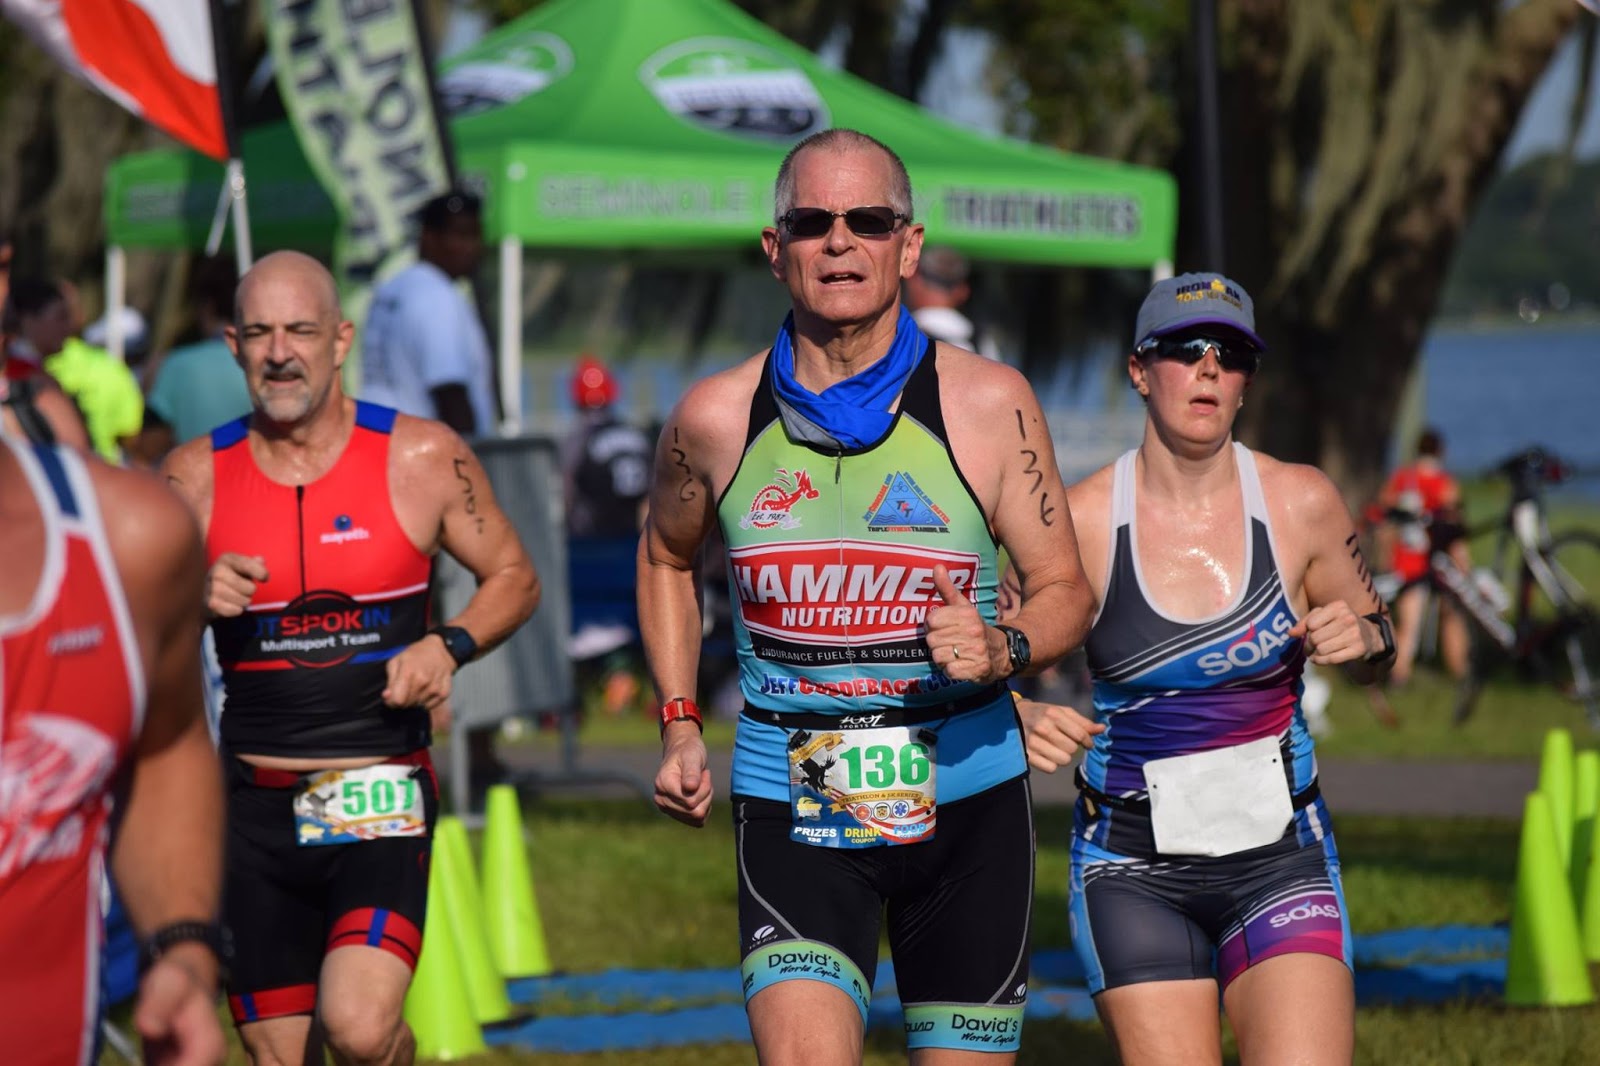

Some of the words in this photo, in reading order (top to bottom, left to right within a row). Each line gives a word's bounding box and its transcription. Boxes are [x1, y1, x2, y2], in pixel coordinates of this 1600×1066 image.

[672, 427, 696, 502] 136
[781, 605, 926, 628] NUTRITION
[260, 637, 336, 652] Multisport
[339, 632, 380, 645] Team
[1197, 612, 1293, 676] SOAS
[761, 647, 813, 661] ENDURANCE
[861, 651, 869, 659] &
[873, 648, 928, 659] SUPPLEM
[839, 742, 931, 789] 136
[342, 779, 416, 816] 507
[794, 826, 838, 838] PRIZES
[845, 827, 882, 838] DRINK
[894, 823, 927, 834] FOOD
[1269, 904, 1340, 928] SOAS
[768, 951, 842, 973] David's
[780, 965, 812, 975] World
[951, 1013, 1018, 1033] David's
[961, 1032, 992, 1043] World
